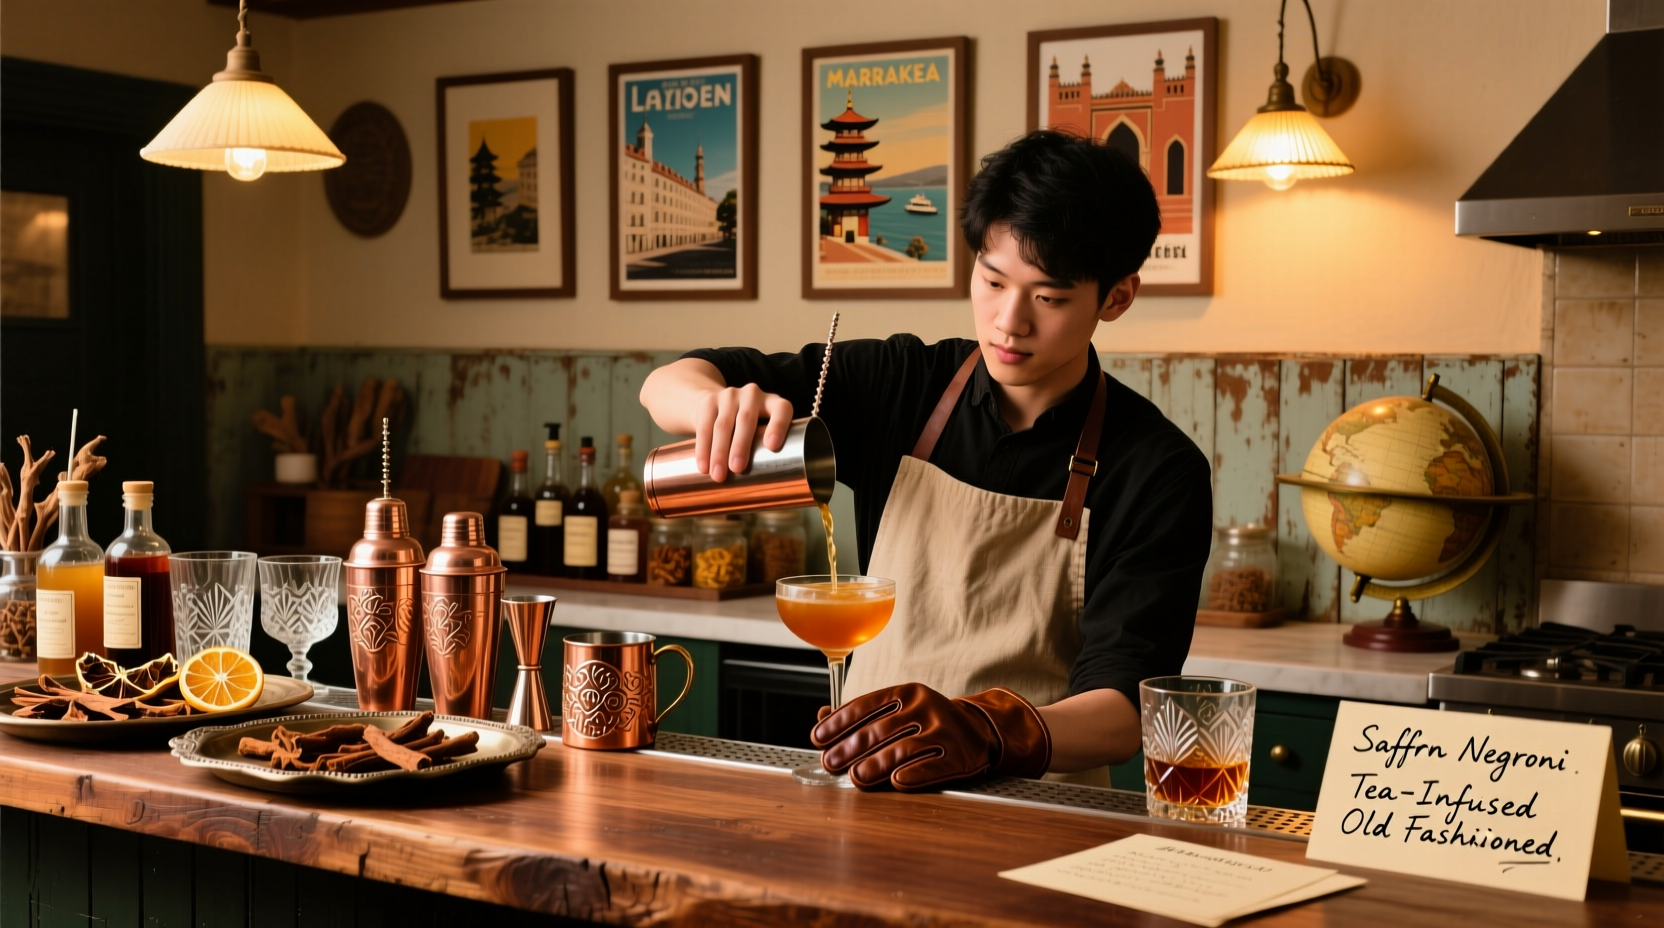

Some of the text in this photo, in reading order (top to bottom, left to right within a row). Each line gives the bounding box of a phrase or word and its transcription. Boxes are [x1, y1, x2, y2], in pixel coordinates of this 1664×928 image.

[826, 62, 941, 89] MARRAKEA
[1353, 724, 1447, 769] Saffrn
[1351, 773, 1538, 825] Tea-Infused
[1341, 808, 1394, 838] Old
